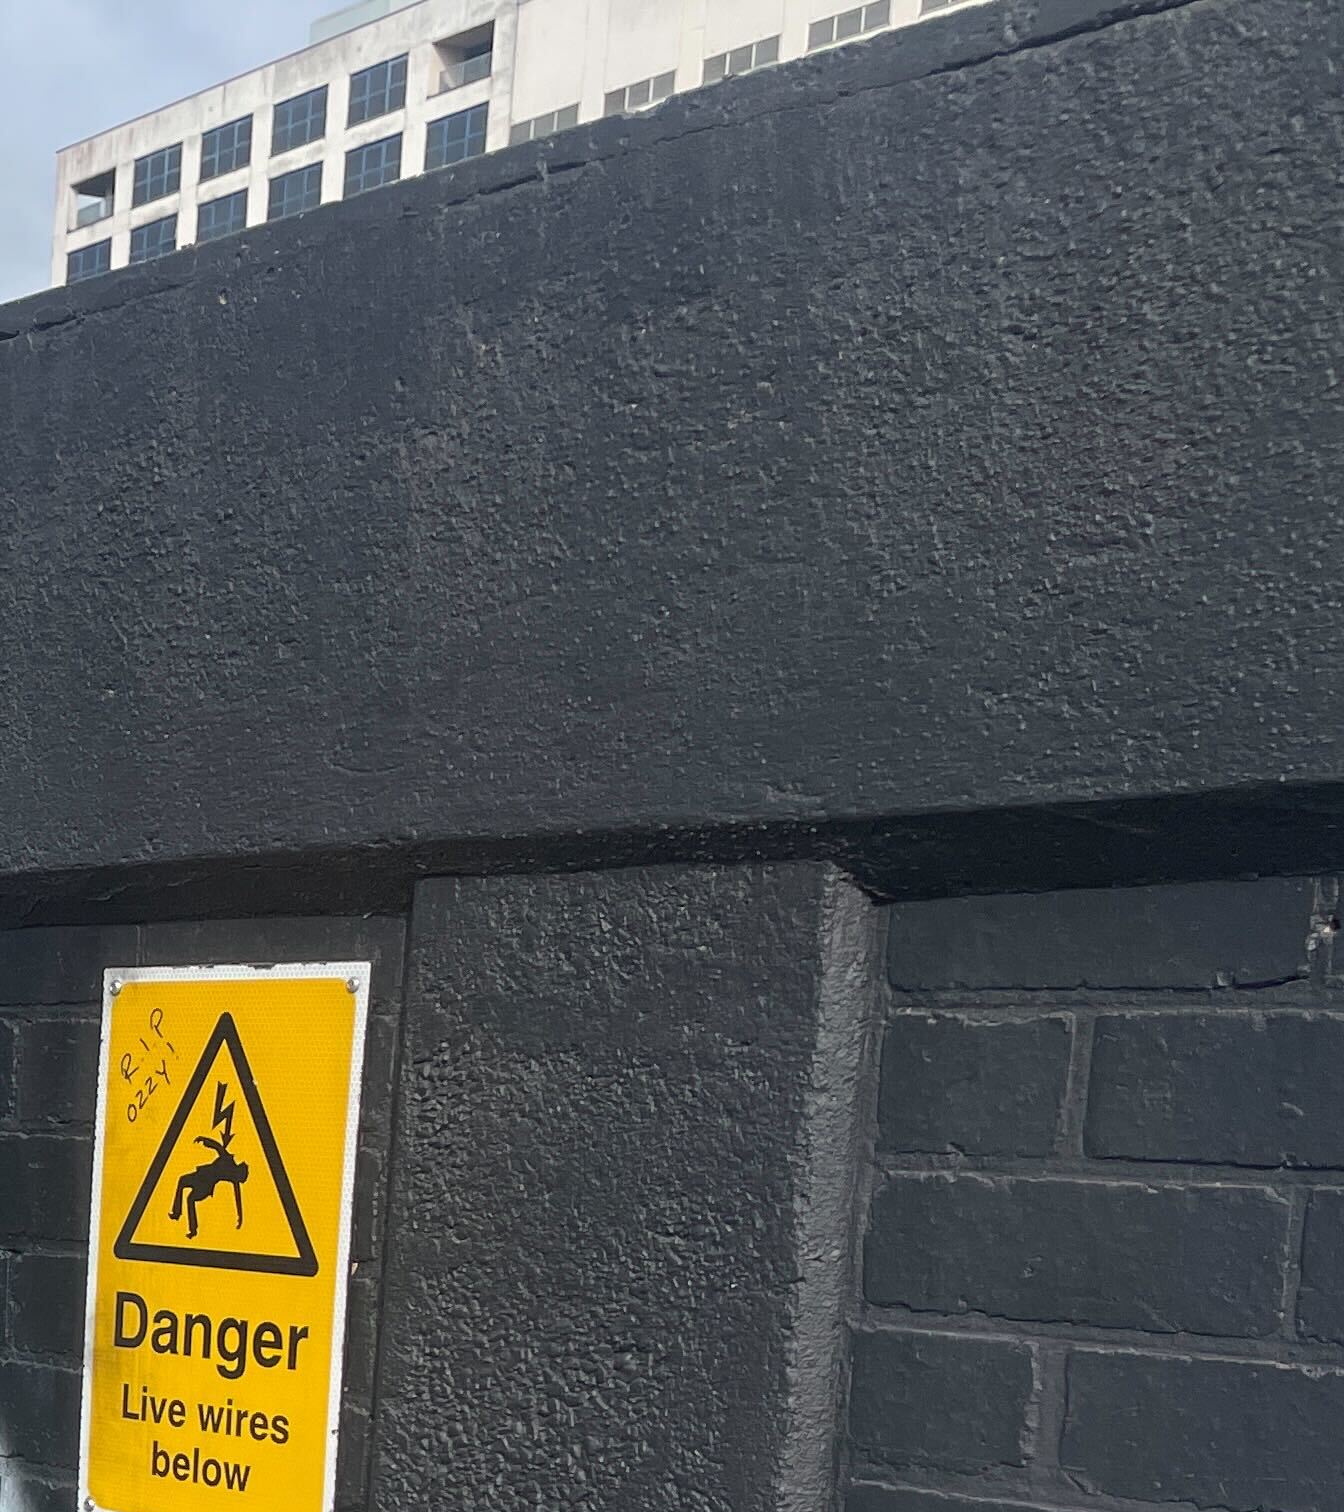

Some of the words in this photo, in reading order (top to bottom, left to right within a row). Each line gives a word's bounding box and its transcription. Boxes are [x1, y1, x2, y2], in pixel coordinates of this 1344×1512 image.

[114, 1291, 310, 1380] Danger
[122, 1383, 186, 1428] Live
[197, 1398, 289, 1444] wires
[151, 1440, 251, 1492] below
